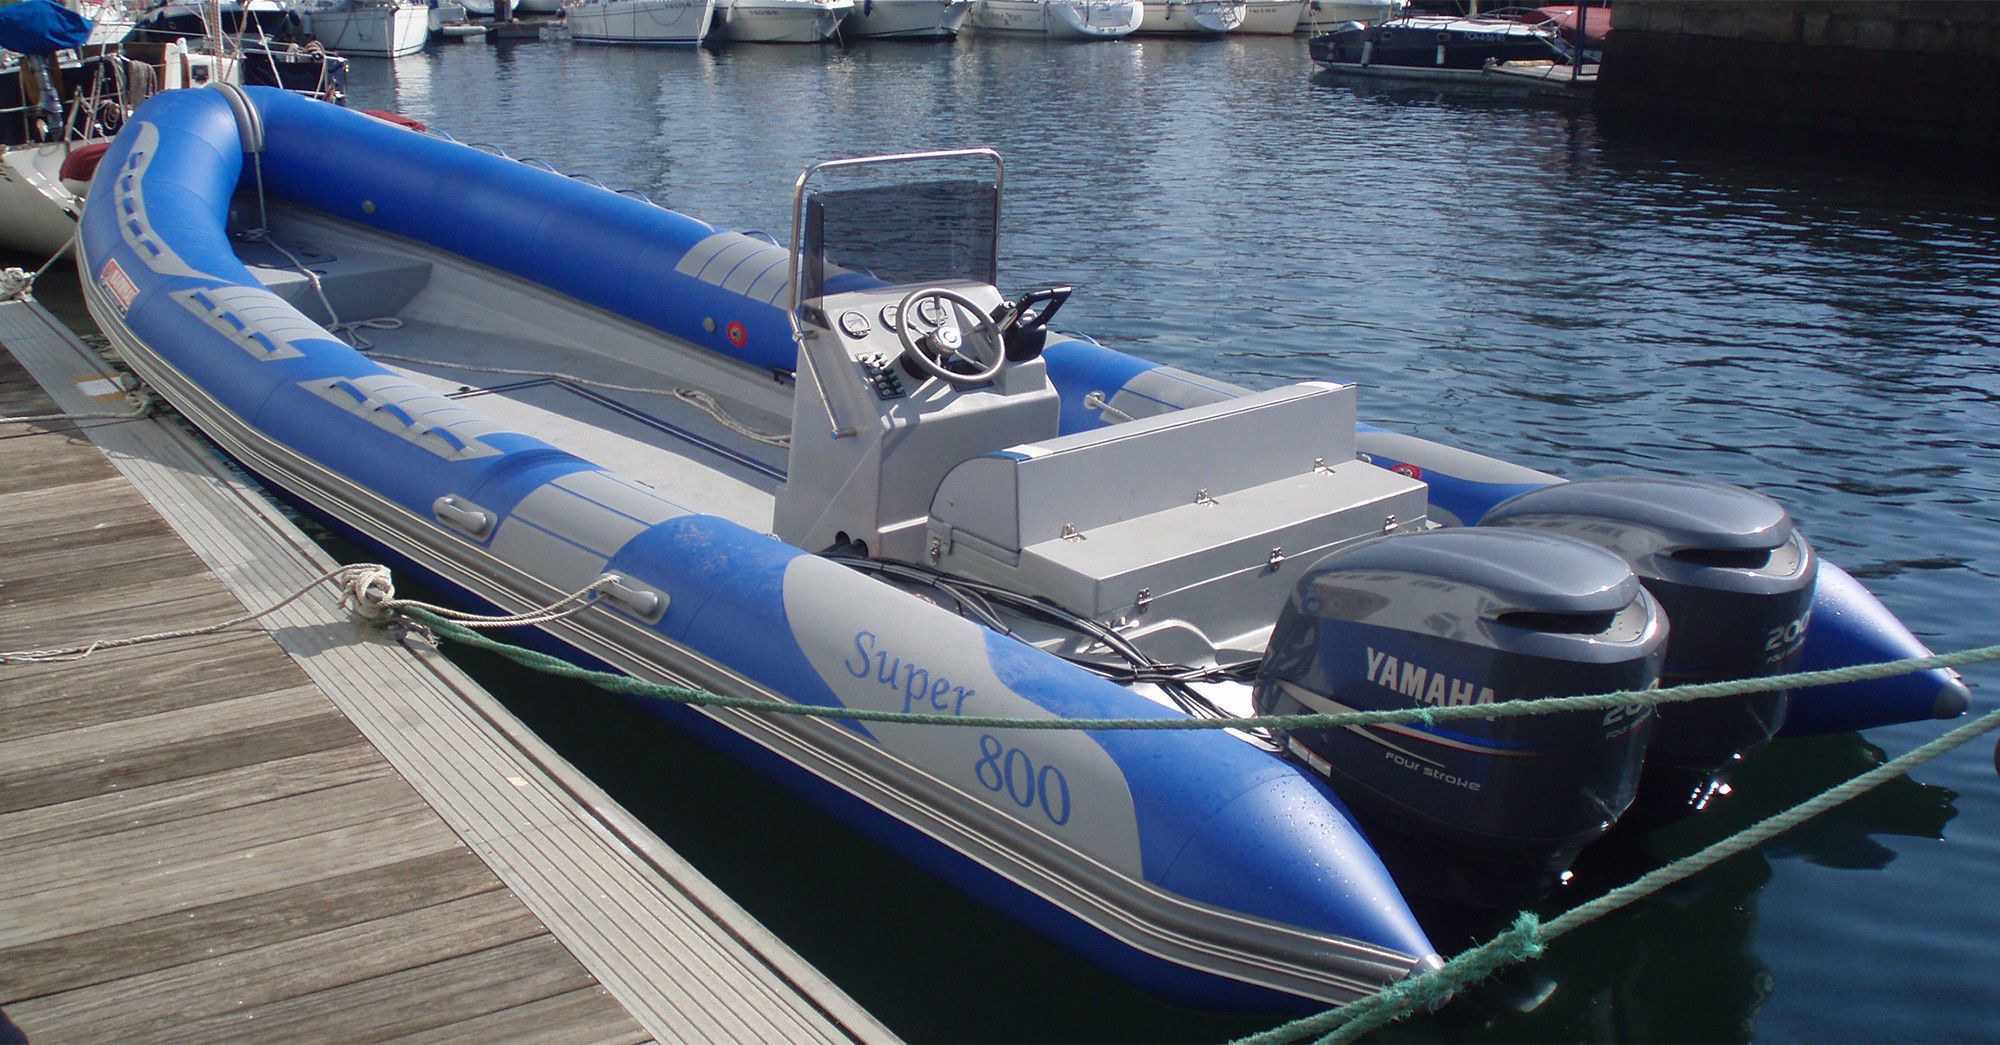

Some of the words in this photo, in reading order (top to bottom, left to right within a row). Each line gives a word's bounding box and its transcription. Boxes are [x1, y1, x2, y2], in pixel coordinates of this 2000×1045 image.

[845, 631, 976, 715] Super
[1366, 646, 1495, 721] YAMAHA
[975, 734, 1071, 826] 800
